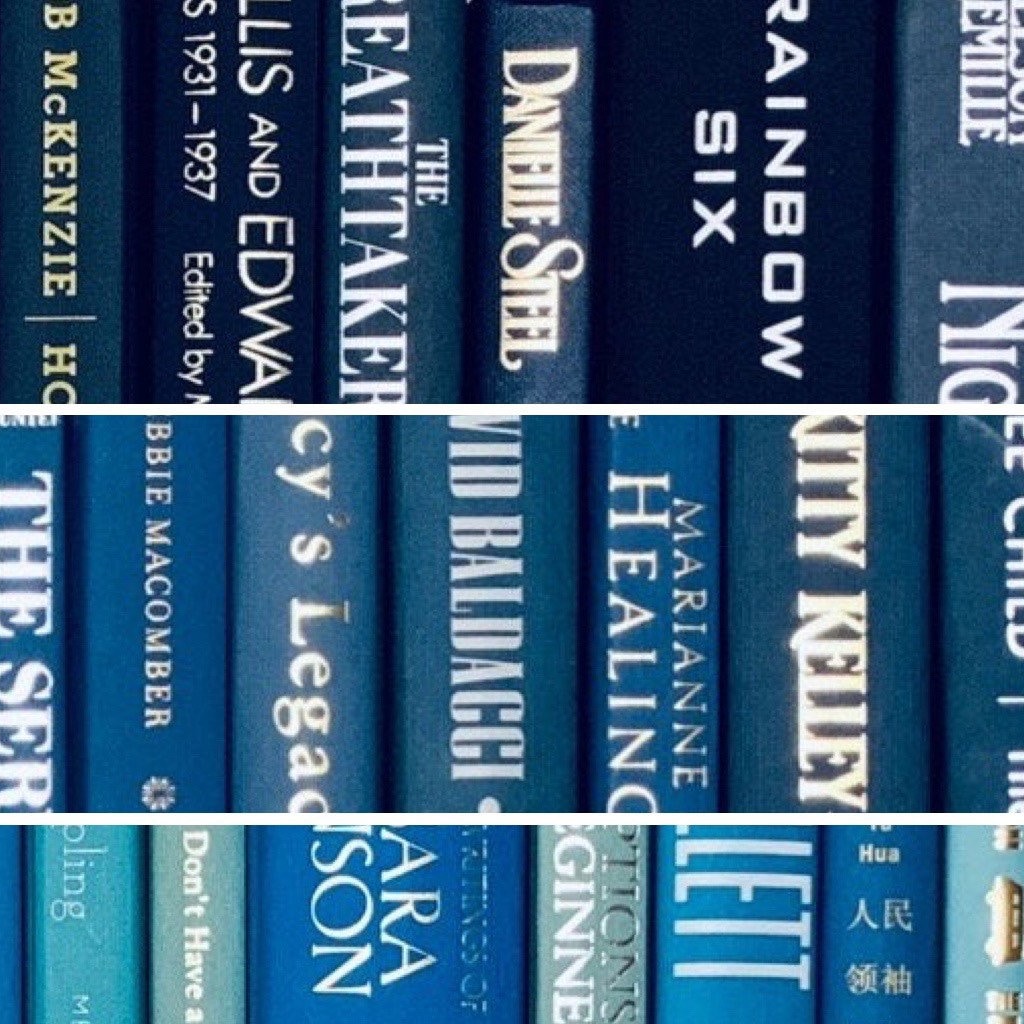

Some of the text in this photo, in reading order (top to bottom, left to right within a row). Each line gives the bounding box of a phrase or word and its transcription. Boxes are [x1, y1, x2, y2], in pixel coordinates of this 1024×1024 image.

[42, 51, 78, 298] McKENZIE
[414, 138, 450, 206] THE
[499, 46, 585, 371] DANIELLE STEEL
[693, 109, 737, 248] SIX
[183, 252, 215, 340] Edited
[237, 112, 294, 404] AND EDWA
[178, 349, 215, 387] by
[144, 423, 173, 729] BBIE MACOMBER
[449, 515, 525, 780] BALDACCI
[673, 497, 708, 788] MARIANNE
[272, 598, 352, 813] Legac
[789, 590, 868, 812] KELLEY
[182, 830, 210, 918] Don't
[858, 842, 901, 863] Hua
[183, 925, 211, 1001] Have
[847, 898, 914, 932] 人民
[184, 1006, 203, 1024] a
[843, 962, 914, 996] 领袖
